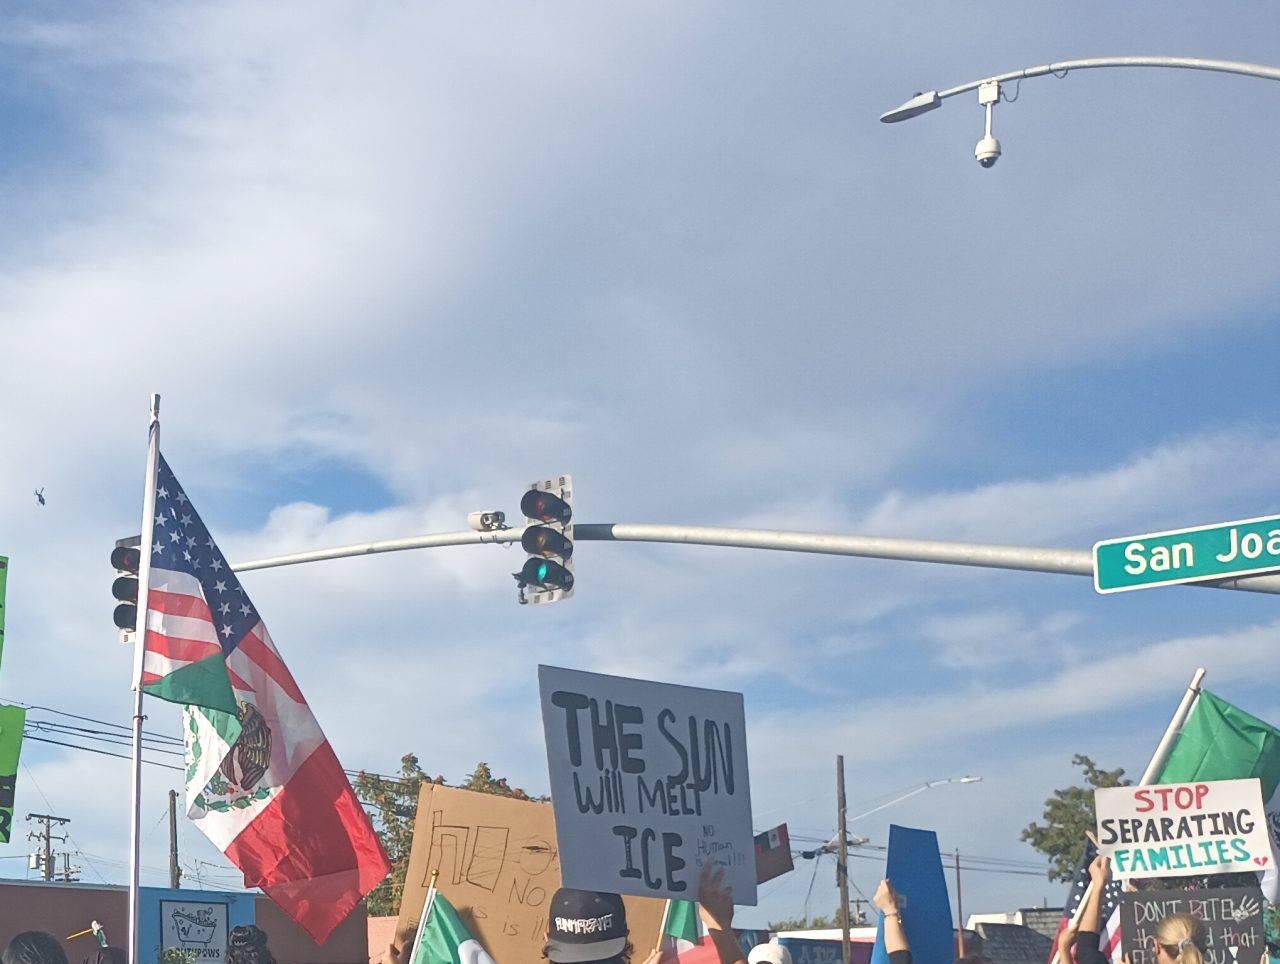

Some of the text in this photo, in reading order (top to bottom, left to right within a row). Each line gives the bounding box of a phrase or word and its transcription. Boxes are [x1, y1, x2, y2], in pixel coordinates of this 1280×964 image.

[1124, 542, 1194, 575] San
[551, 690, 735, 796] THE SUN
[637, 775, 702, 816] MELT
[1134, 784, 1209, 813] STOP
[1101, 809, 1255, 844] SEPARATING
[613, 825, 687, 892] ICE
[1114, 838, 1251, 872] FAMILIES
[508, 877, 546, 907] NO
[1189, 898, 1233, 921] BITE
[1133, 927, 1155, 949] th
[1220, 926, 1259, 948] that
